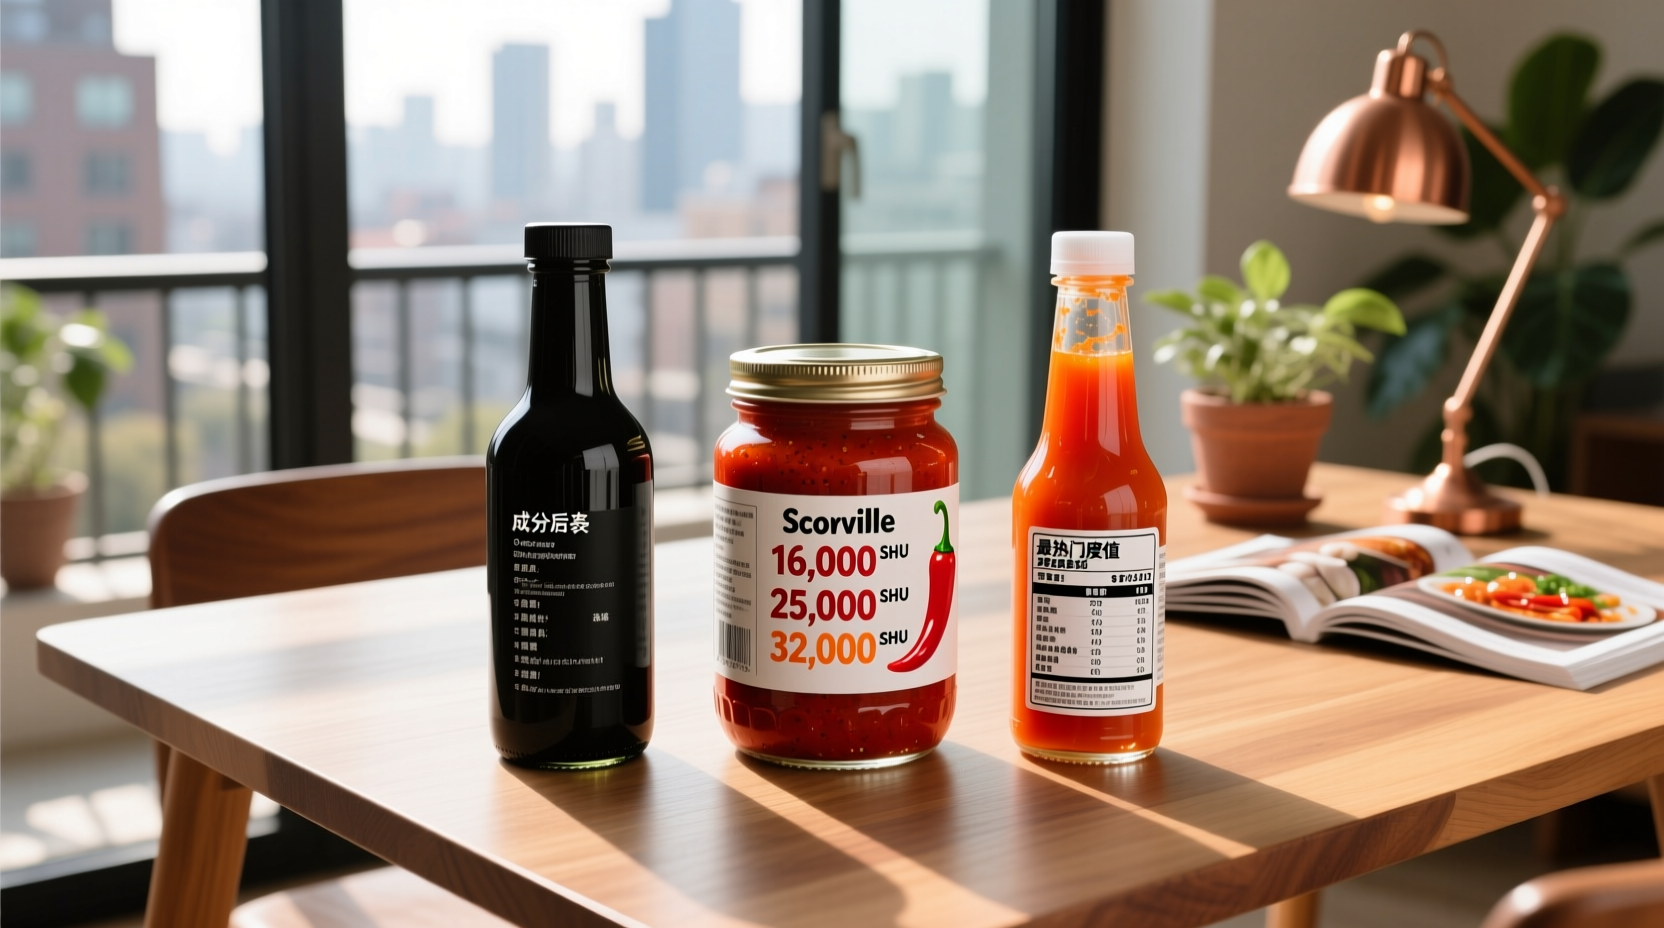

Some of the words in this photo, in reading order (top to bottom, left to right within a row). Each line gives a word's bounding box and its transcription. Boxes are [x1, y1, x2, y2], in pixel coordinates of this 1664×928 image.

[782, 507, 895, 535] Scorville
[771, 544, 877, 583] 16,000
[879, 543, 909, 560] SHU
[770, 587, 877, 627] 25,000
[879, 586, 909, 603] SHU
[770, 630, 877, 670] 32,000
[879, 629, 909, 646] SHU
